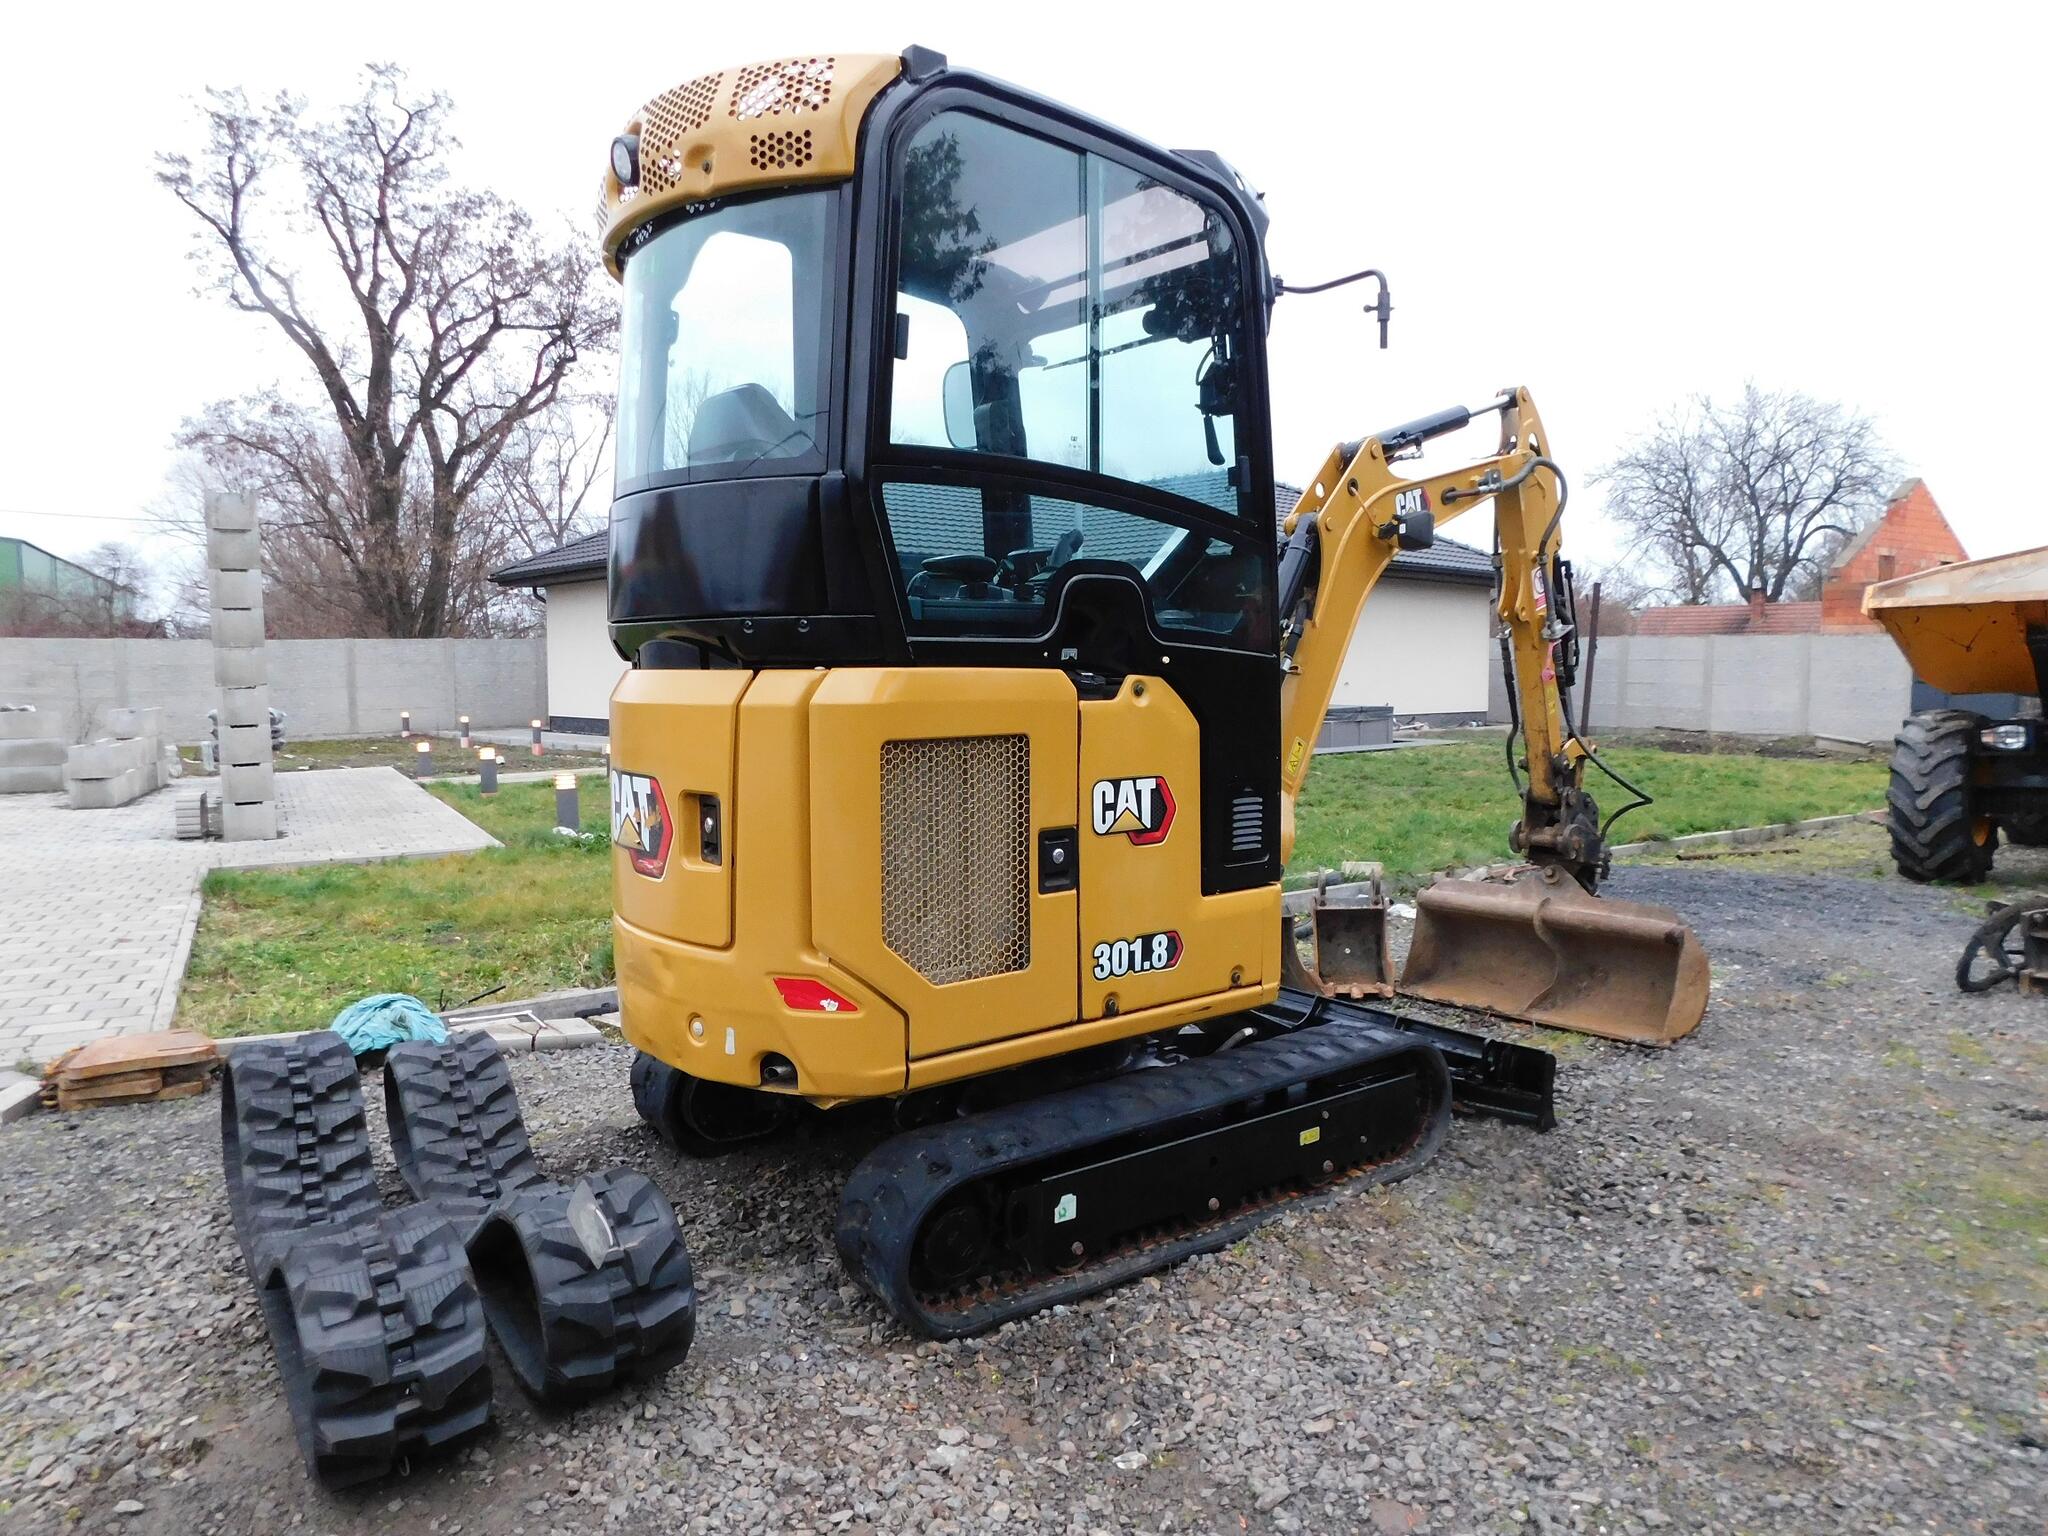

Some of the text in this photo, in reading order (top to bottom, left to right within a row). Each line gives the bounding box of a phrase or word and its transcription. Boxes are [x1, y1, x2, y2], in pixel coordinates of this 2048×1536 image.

[1395, 488, 1422, 516] CAT
[611, 770, 651, 852] CAT
[1093, 778, 1156, 834] CAT
[1094, 933, 1168, 979] 301.8
